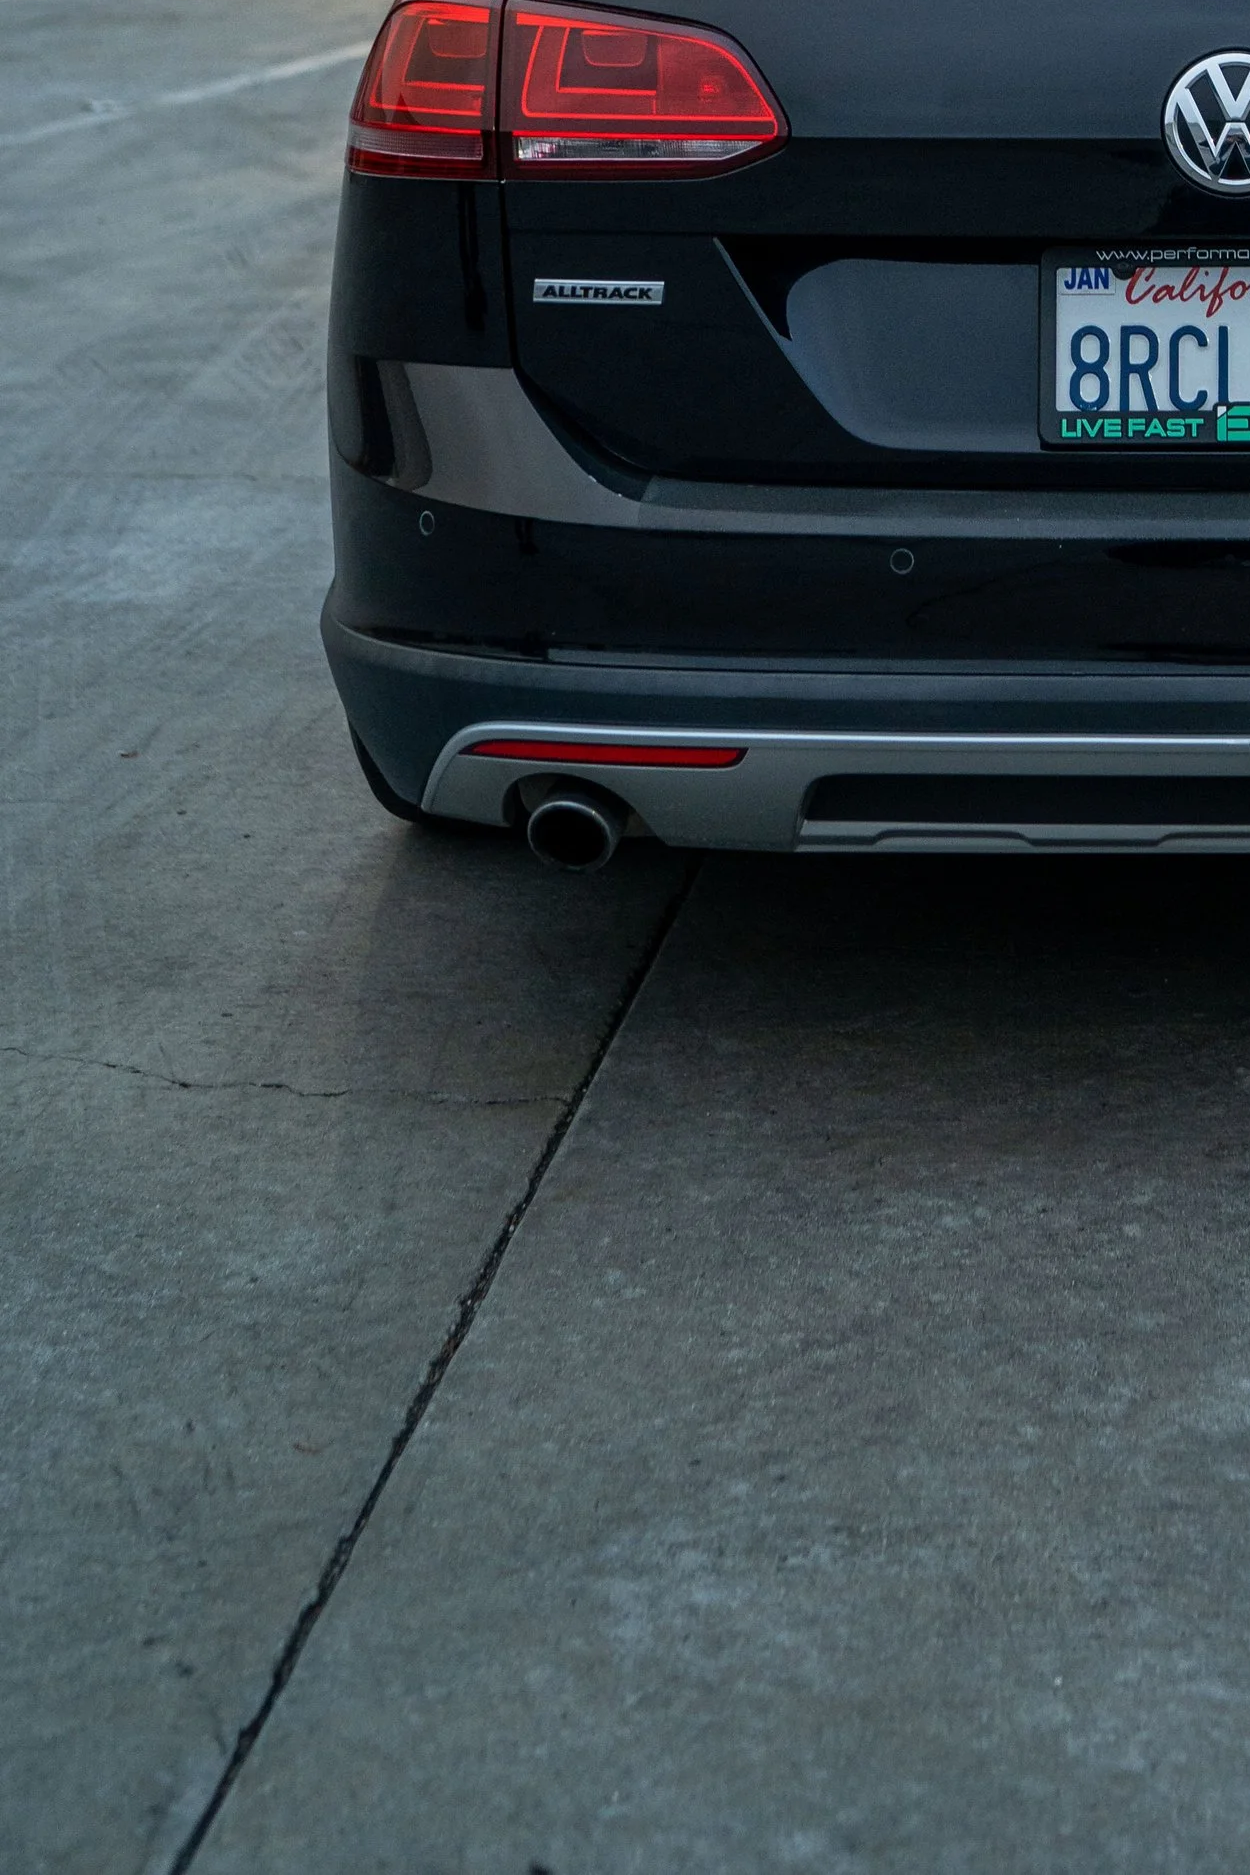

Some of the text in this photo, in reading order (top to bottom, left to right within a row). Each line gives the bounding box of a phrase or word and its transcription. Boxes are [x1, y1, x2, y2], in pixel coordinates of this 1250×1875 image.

[1064, 268, 1109, 290] JAN
[542, 285, 653, 300] ALLTRACK
[1061, 418, 1204, 438] LIVE FAST
